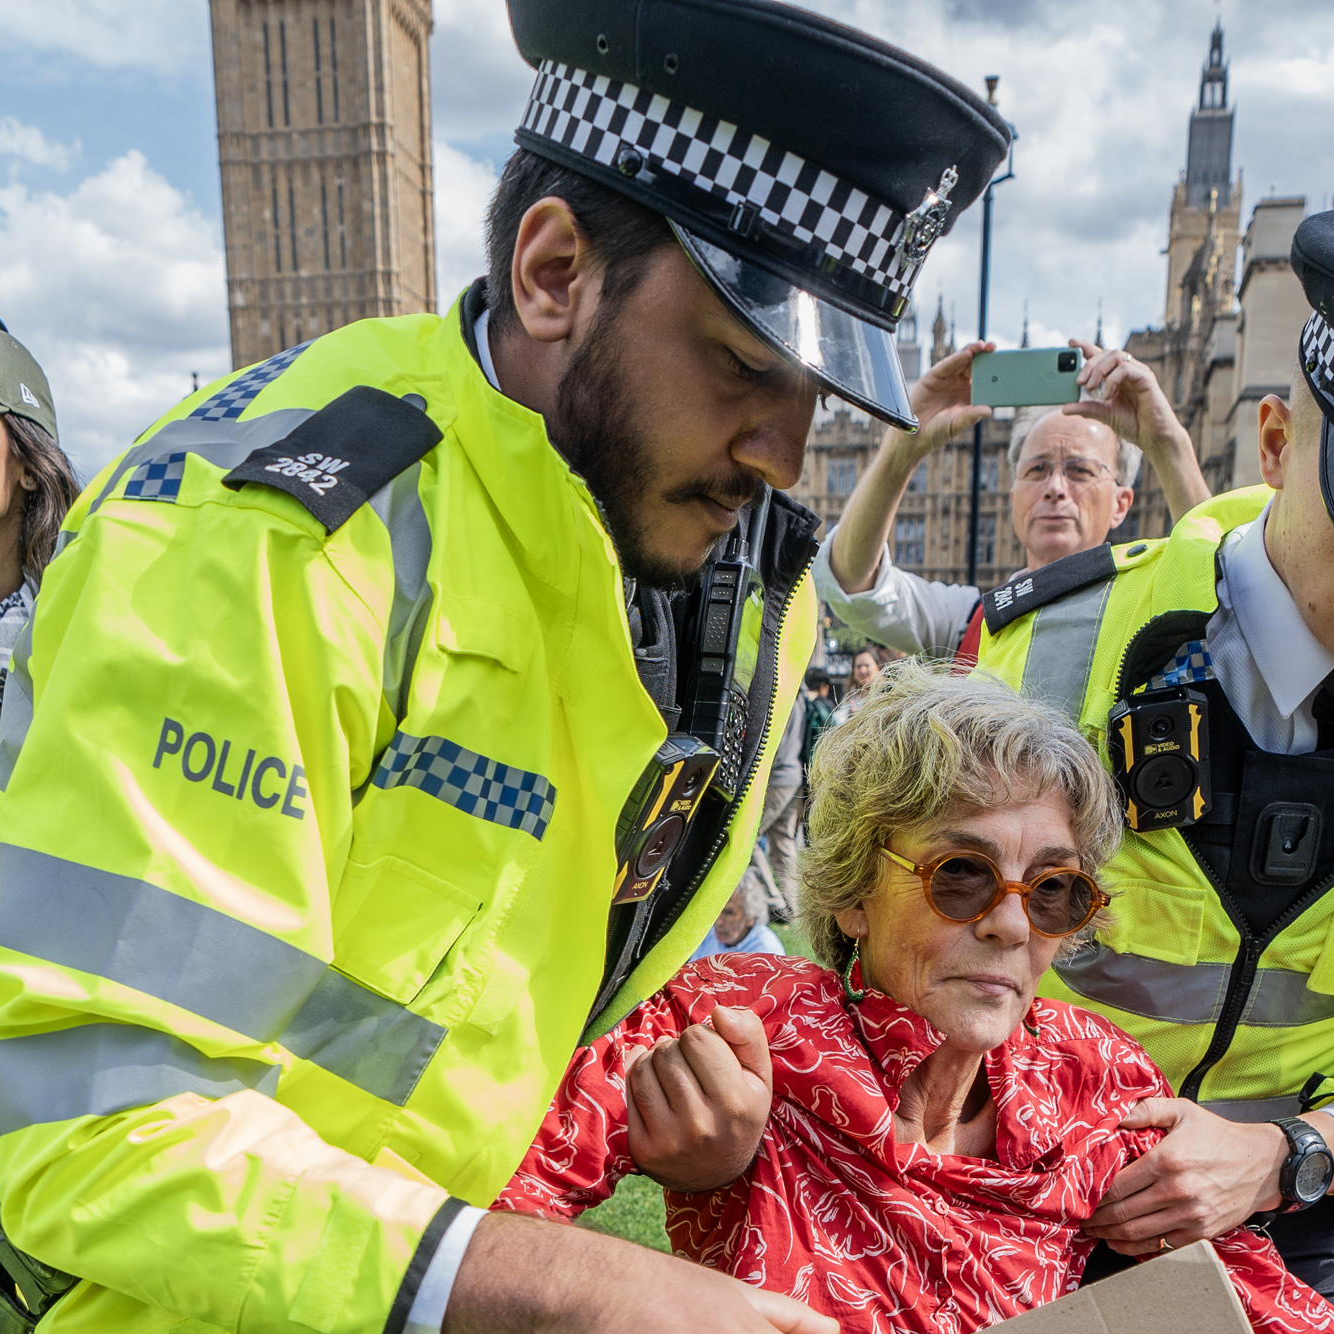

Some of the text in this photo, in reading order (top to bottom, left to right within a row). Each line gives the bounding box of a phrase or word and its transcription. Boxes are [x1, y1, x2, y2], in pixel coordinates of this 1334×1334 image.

[297, 453, 350, 474] SW
[264, 457, 338, 496] 2842
[1015, 578, 1034, 598] SW
[994, 586, 1014, 611] 2841
[1163, 744, 1180, 752] AUDIO
[152, 717, 308, 820] POLICE
[1155, 810, 1178, 819] AXON
[632, 881, 648, 890] AXON
